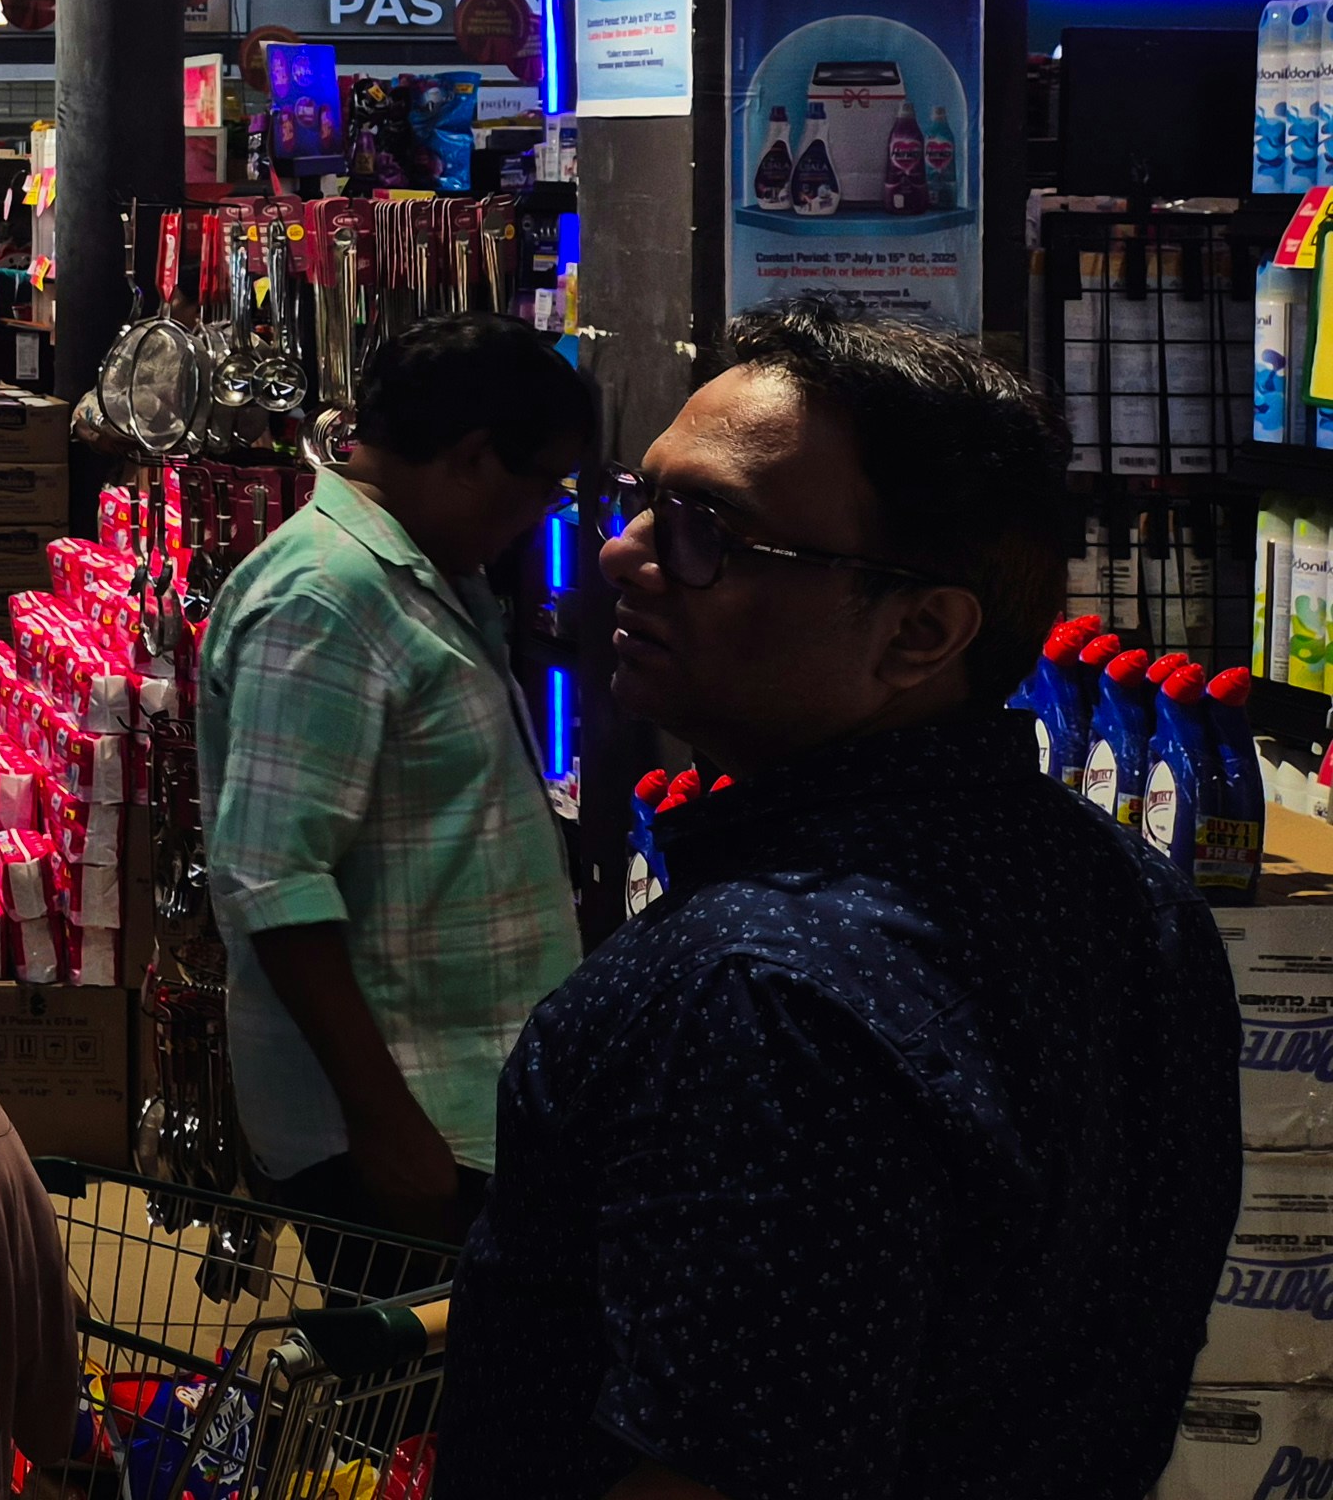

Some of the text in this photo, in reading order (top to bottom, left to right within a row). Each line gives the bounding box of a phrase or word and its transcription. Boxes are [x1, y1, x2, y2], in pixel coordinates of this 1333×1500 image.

[853, 253, 873, 265] July
[1205, 818, 1242, 833] BUY
[1206, 831, 1239, 845] GET
[1204, 847, 1248, 861] FREE
[1238, 994, 1305, 1007] CLEANER
[1234, 1234, 1300, 1247] CLEANER
[1215, 1266, 1333, 1321] PROTEC
